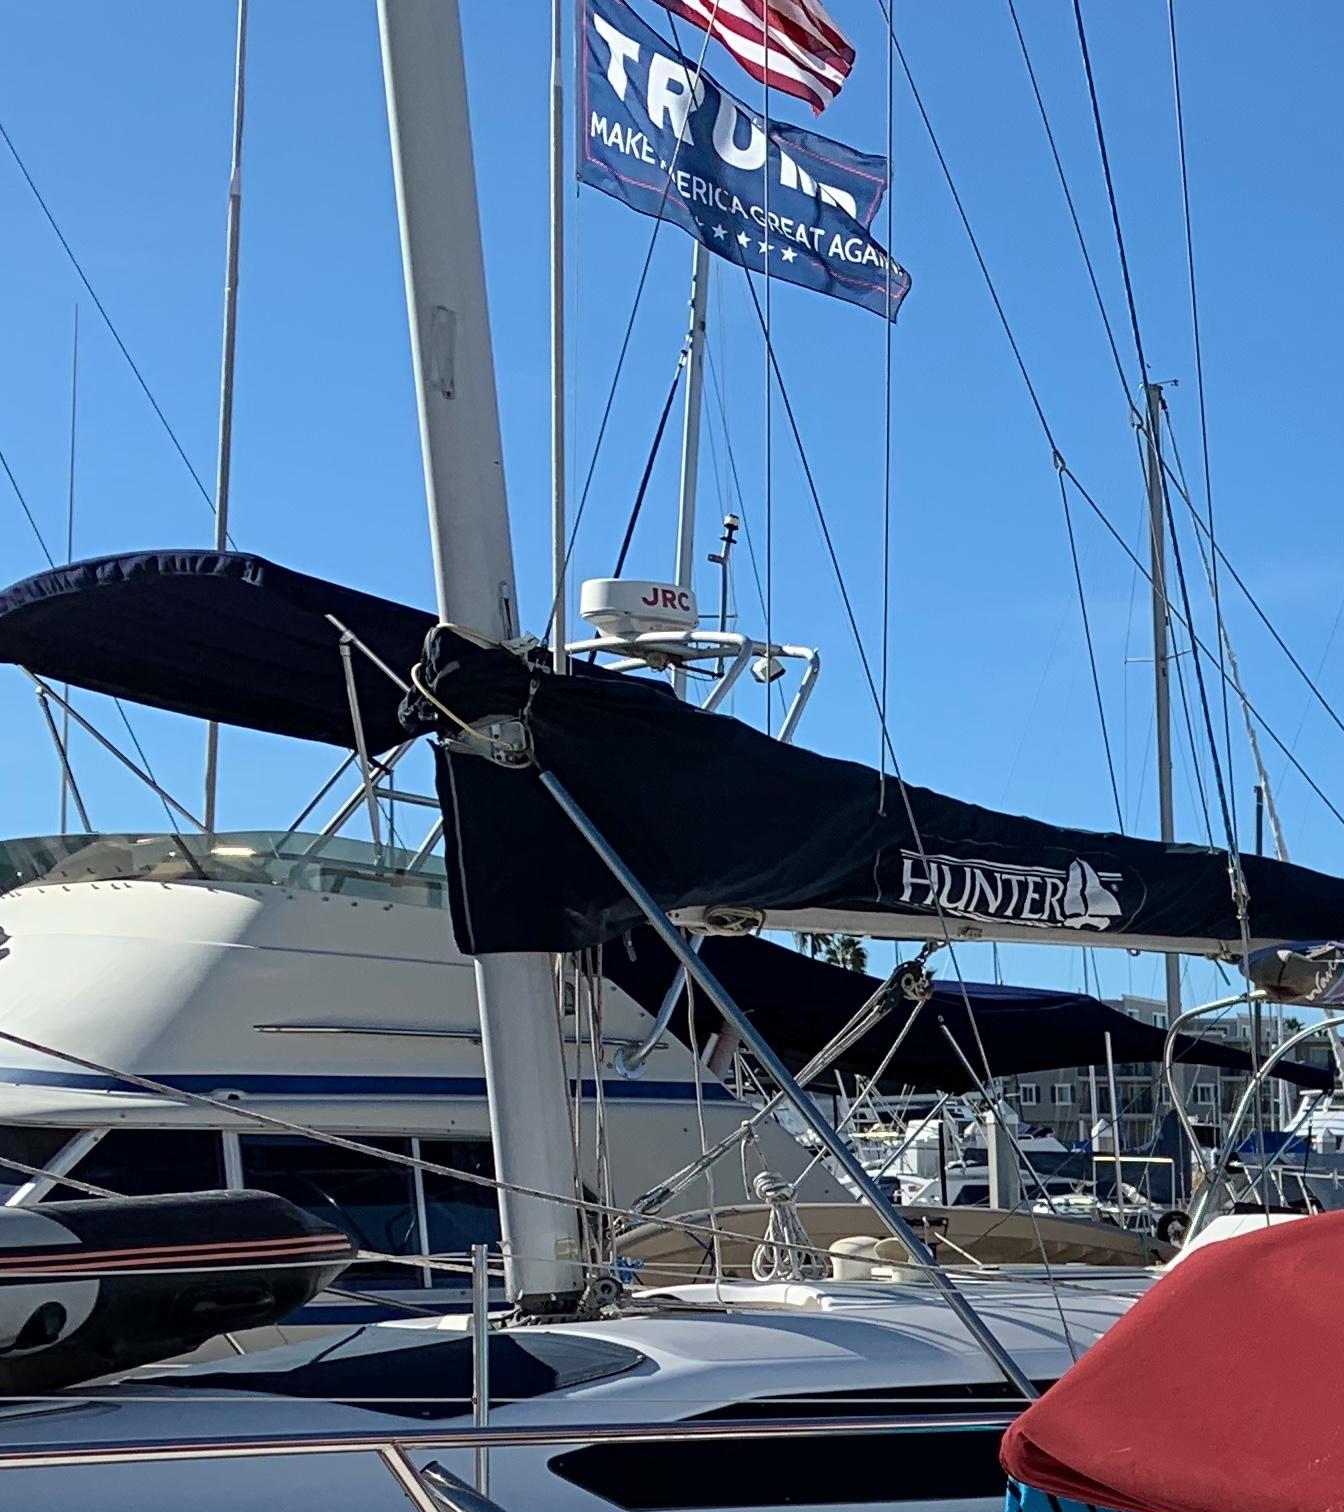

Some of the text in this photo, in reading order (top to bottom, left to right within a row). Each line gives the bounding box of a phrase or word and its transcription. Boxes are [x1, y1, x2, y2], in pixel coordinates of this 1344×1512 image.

[590, 110, 656, 165] MAKE
[750, 205, 826, 252] GREAT
[641, 587, 690, 611] JRC
[900, 858, 1066, 922] HUNTER
